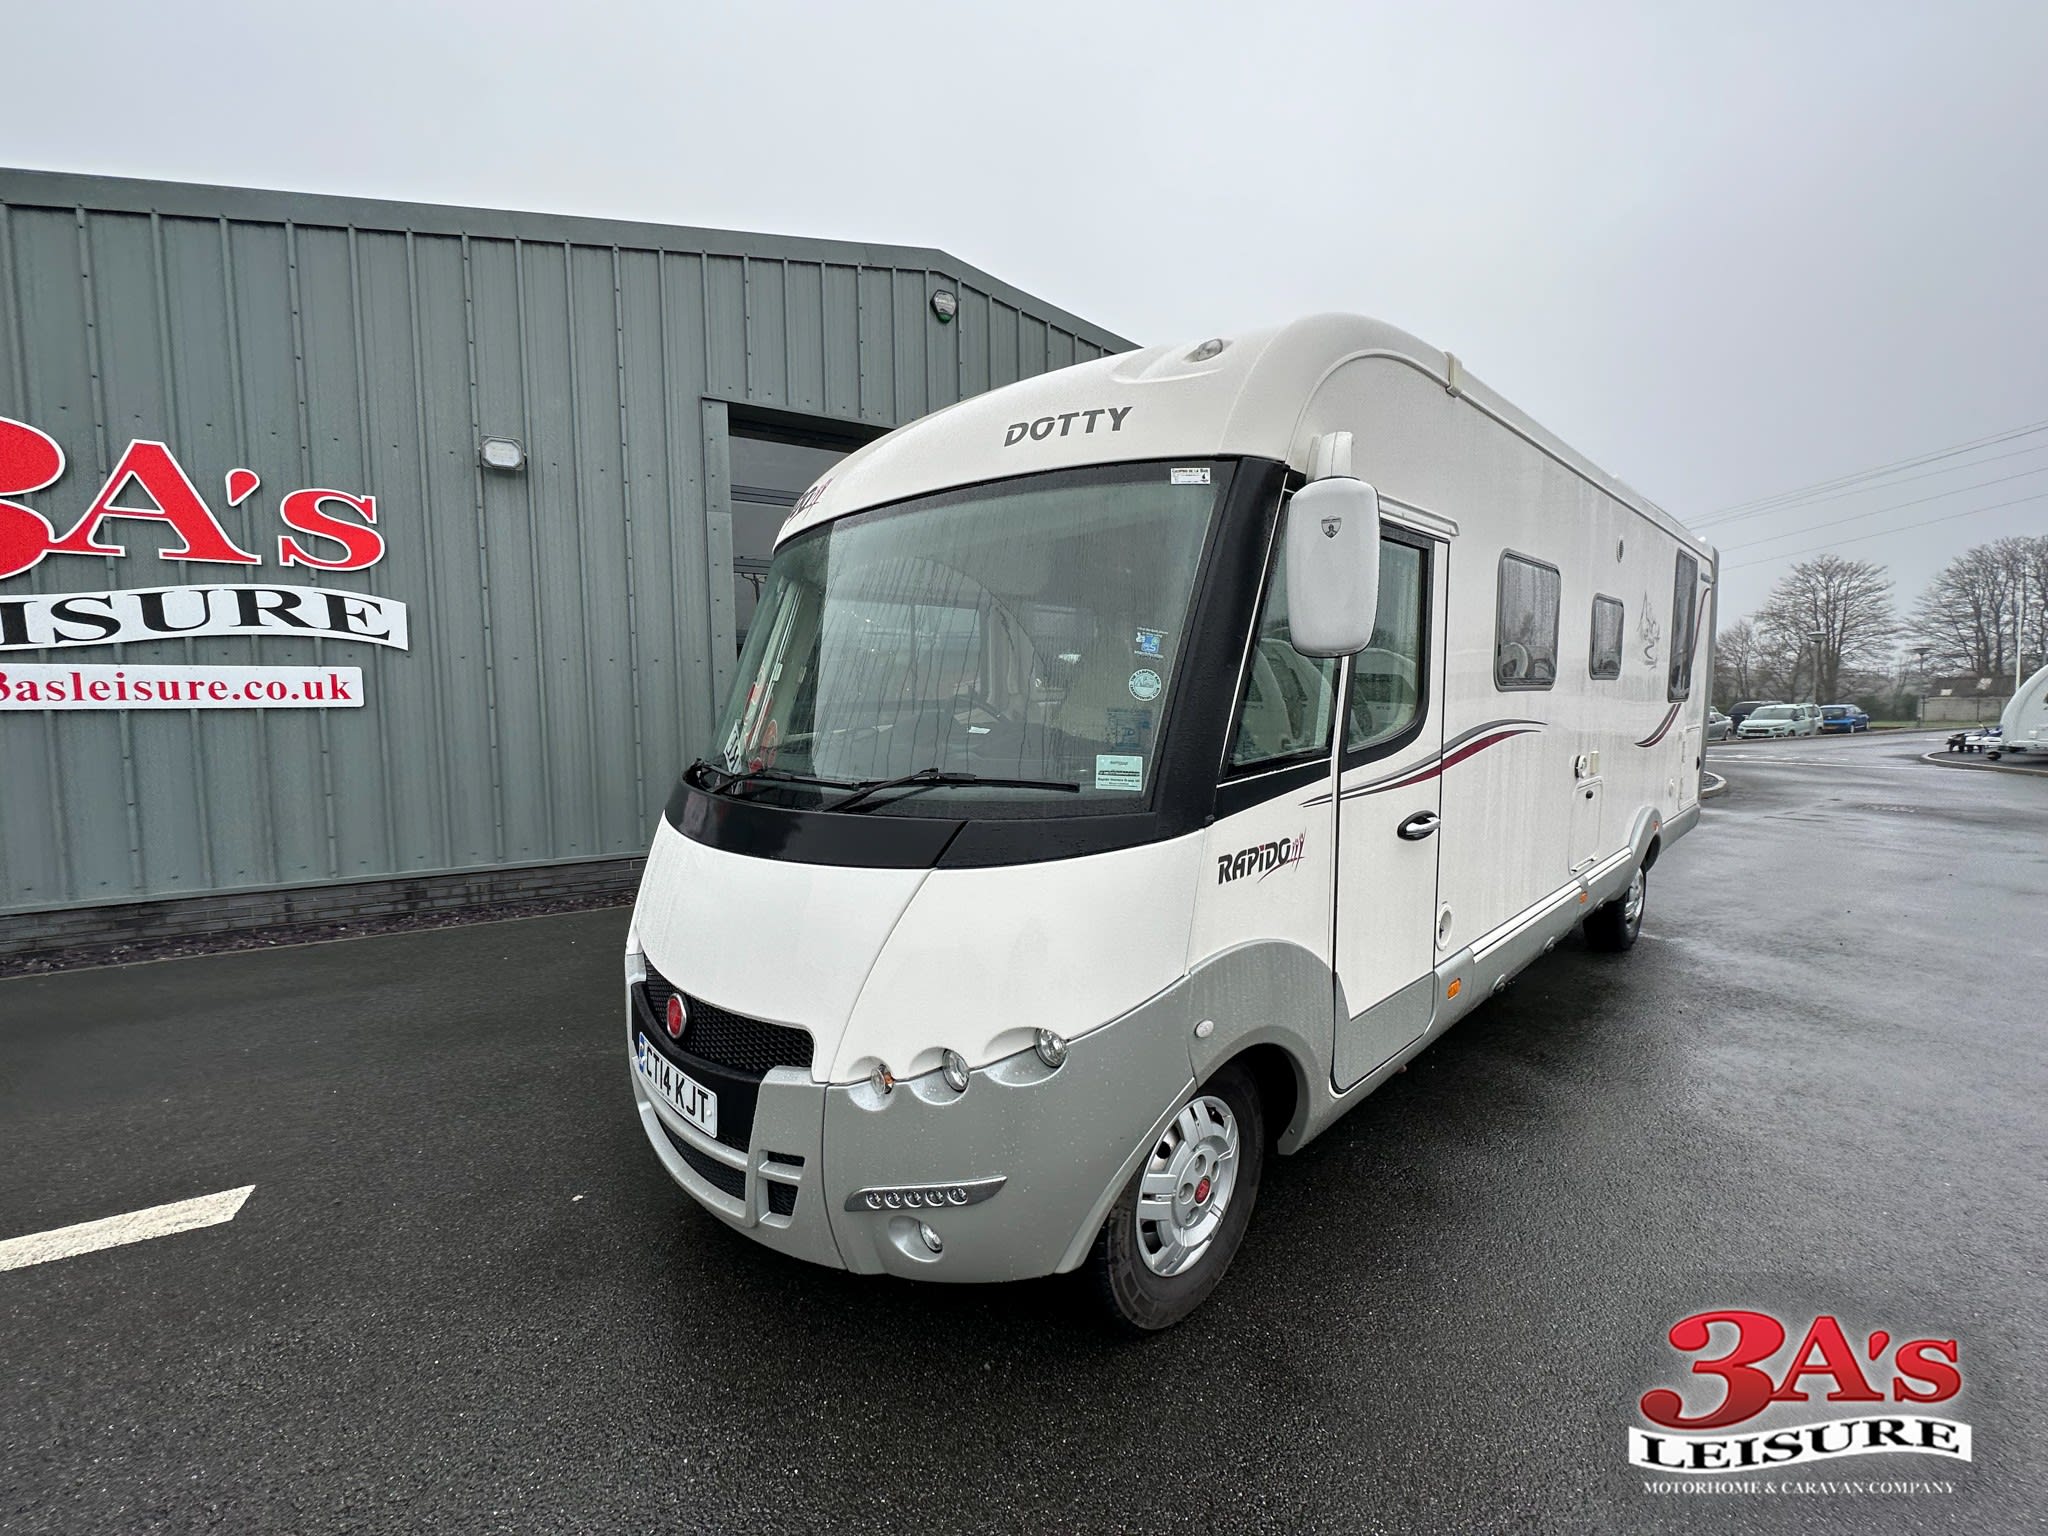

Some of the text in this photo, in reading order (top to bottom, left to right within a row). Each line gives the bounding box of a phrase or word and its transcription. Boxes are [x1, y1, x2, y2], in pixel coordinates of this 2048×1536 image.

[1004, 406, 1133, 447] DOTTY
[0, 416, 385, 580] A's
[646, 1046, 709, 1123] CT14 KJT
